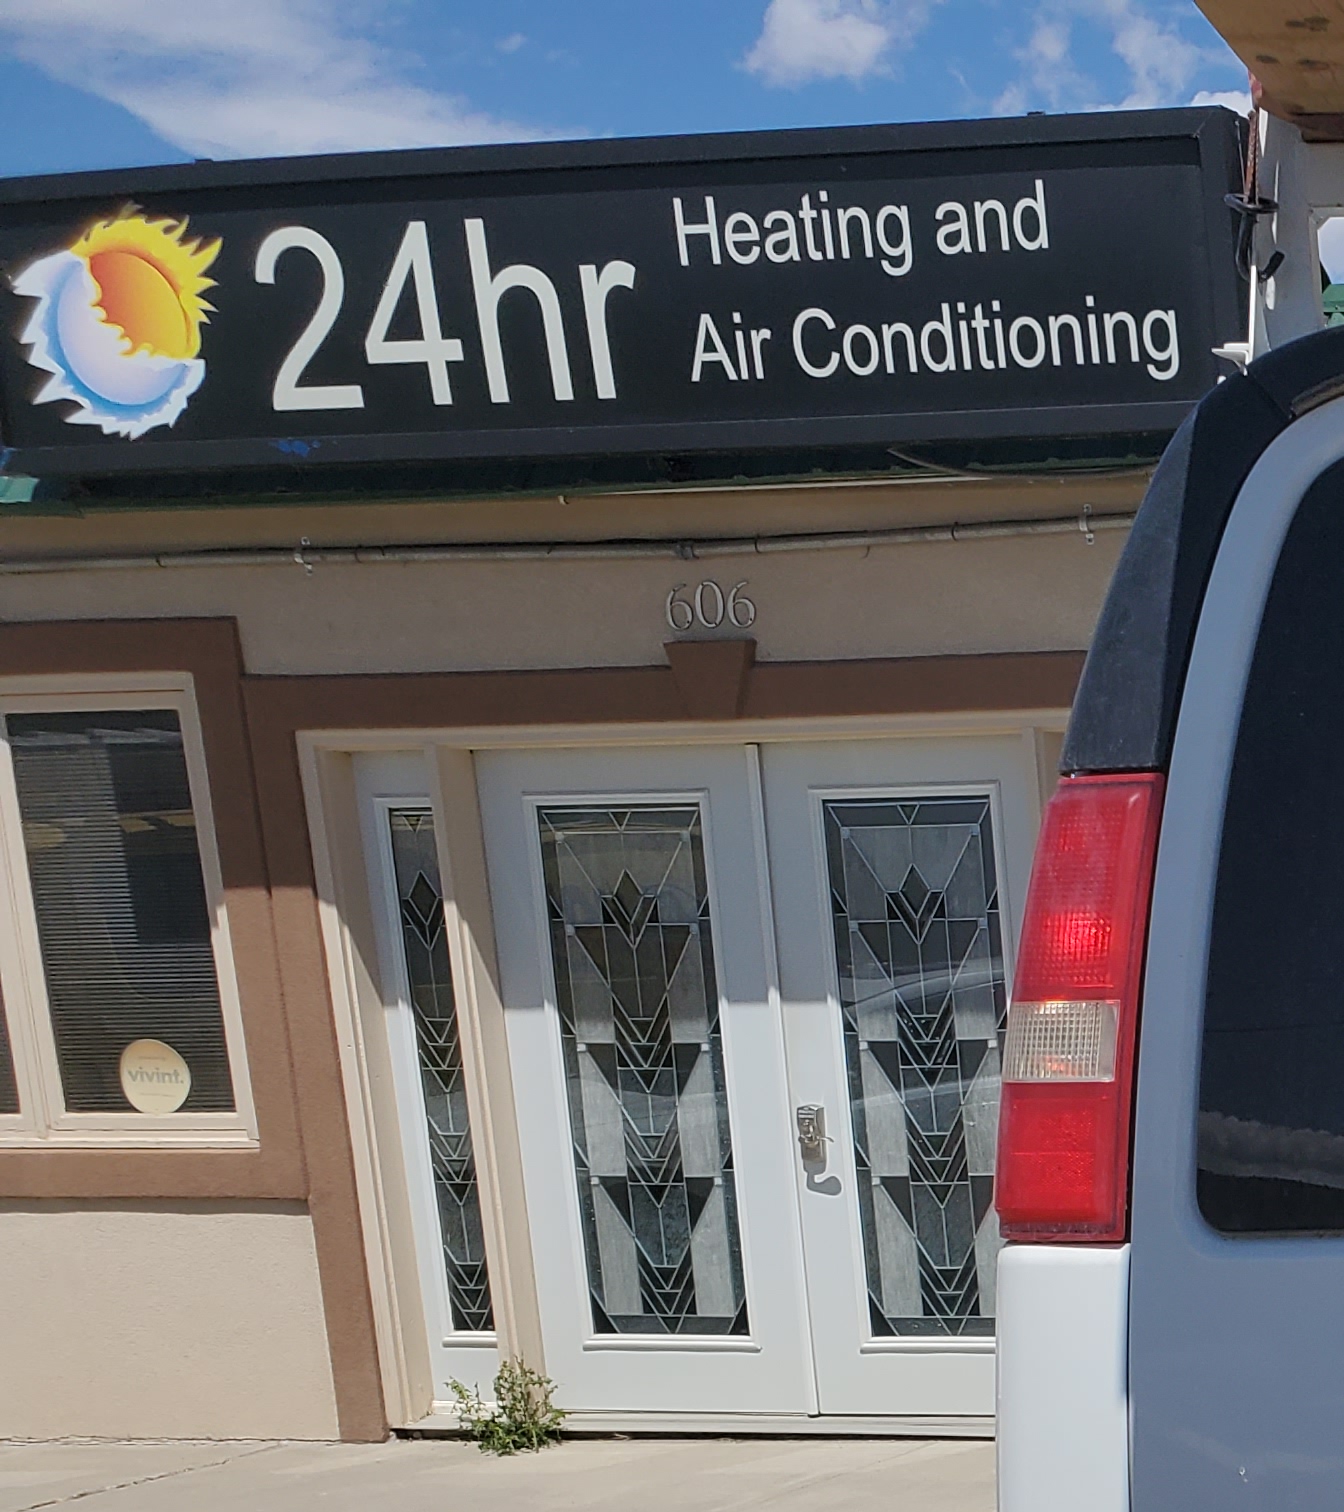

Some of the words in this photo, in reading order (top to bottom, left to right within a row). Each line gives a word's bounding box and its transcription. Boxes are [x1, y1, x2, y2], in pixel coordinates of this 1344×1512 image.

[673, 190, 916, 275] Heating
[935, 179, 1049, 257] and
[254, 217, 635, 412] 24hr
[691, 311, 769, 384] Air
[792, 296, 1178, 381] Conditioning
[665, 580, 757, 630] 606
